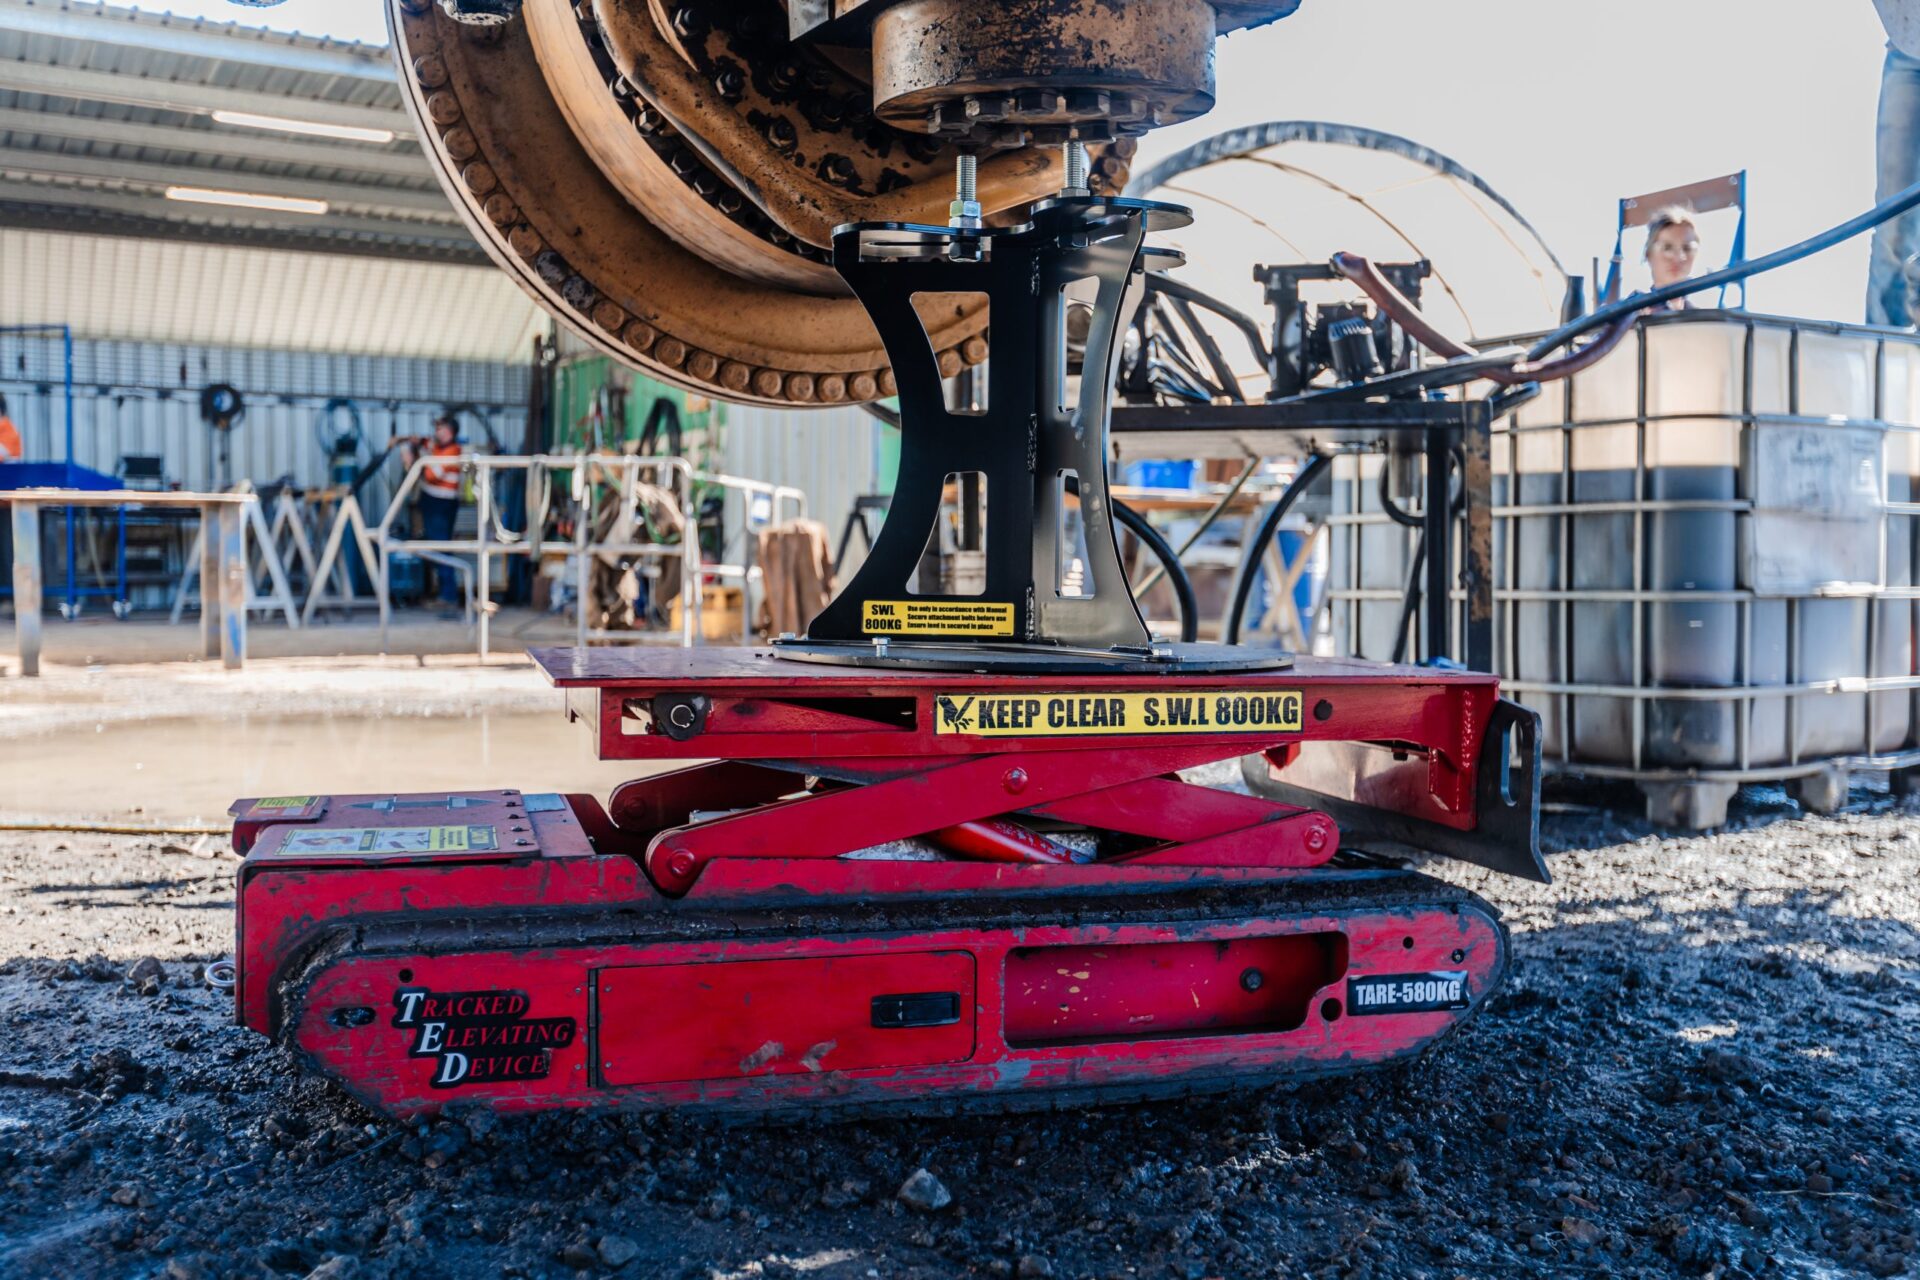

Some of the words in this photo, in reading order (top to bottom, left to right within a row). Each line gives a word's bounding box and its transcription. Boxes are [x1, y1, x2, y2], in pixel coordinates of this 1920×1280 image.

[871, 604, 895, 615] SWL
[919, 605, 931, 613] only
[865, 618, 902, 630] 800KG
[978, 700, 1041, 729] KEEP
[1047, 699, 1125, 728] CLEAR
[1143, 697, 1209, 726] S.W.L
[1215, 696, 1298, 725] 800KG
[1356, 980, 1461, 1006] TARE-580KG
[399, 992, 524, 1023] TRACKED
[416, 1022, 571, 1053] ELEVATING
